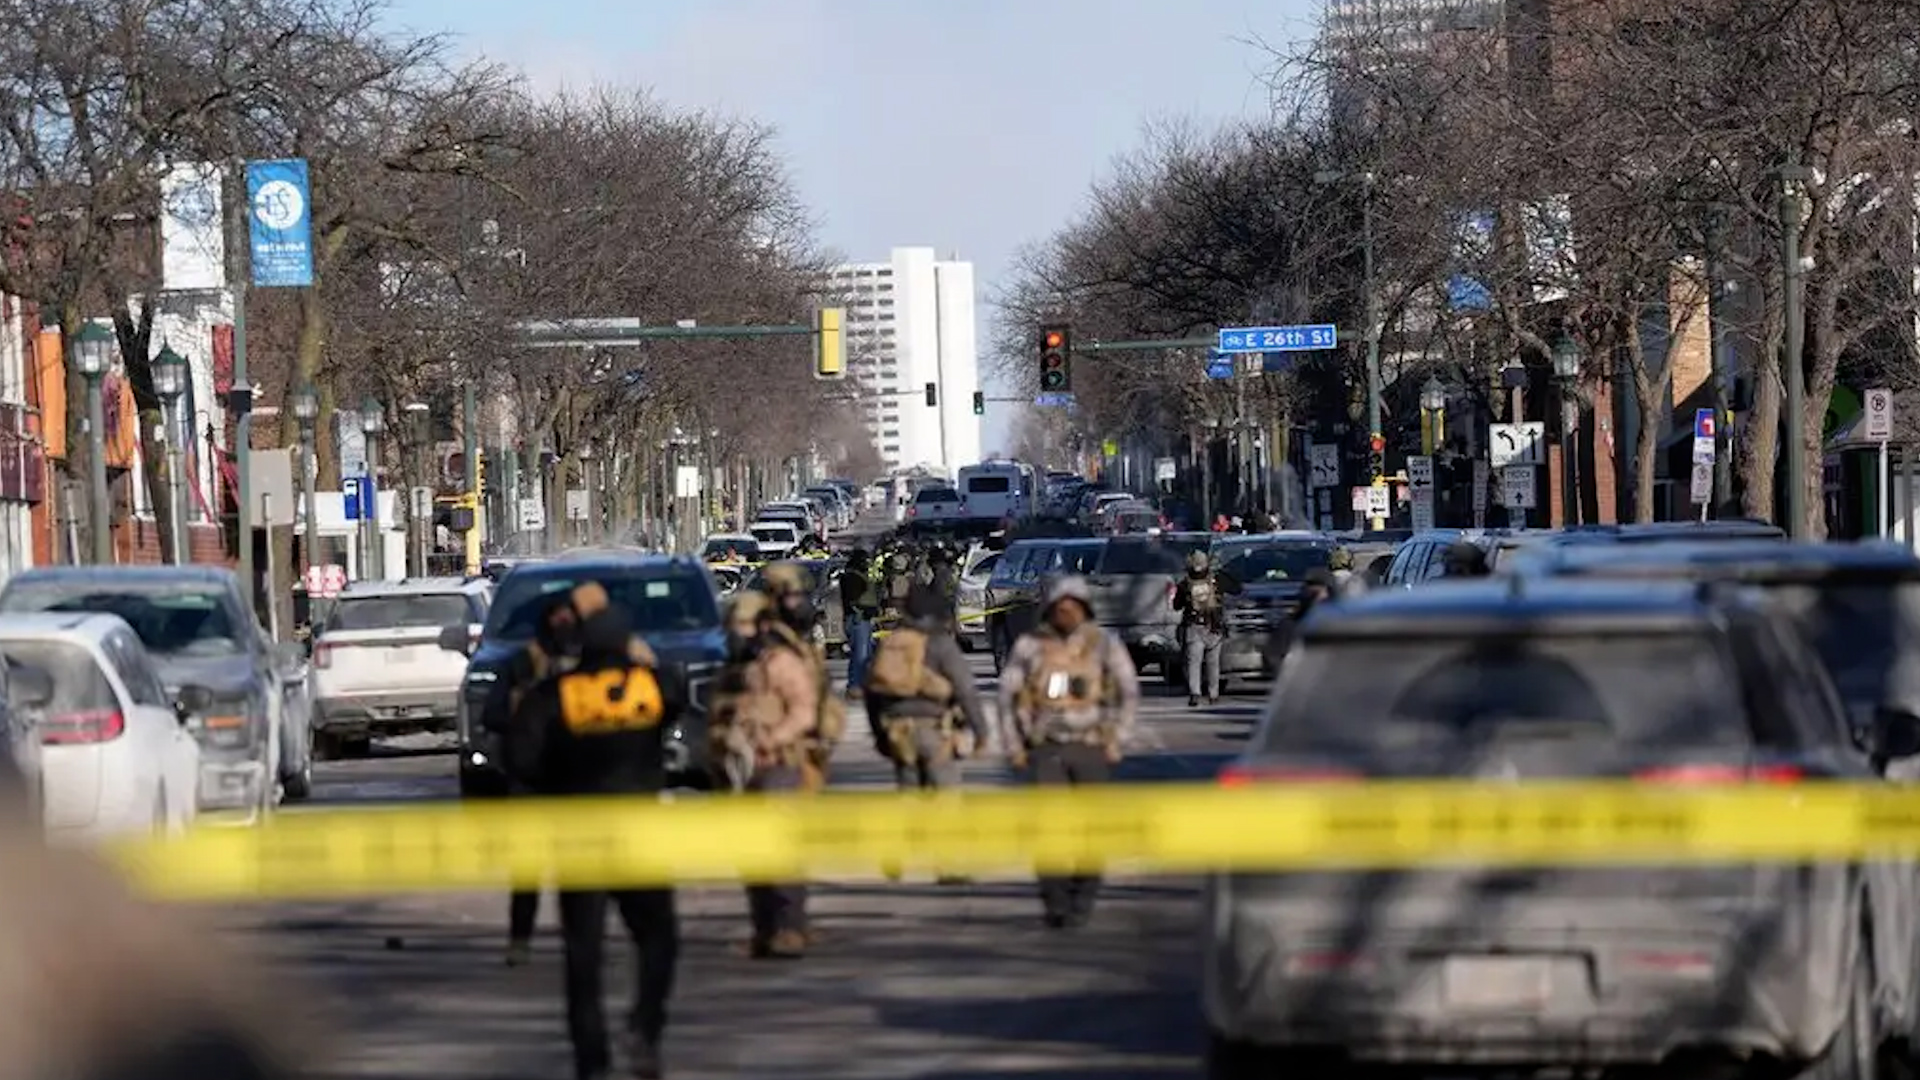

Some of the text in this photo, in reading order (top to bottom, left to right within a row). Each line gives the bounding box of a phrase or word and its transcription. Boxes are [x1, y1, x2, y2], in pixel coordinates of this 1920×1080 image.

[1245, 330, 1332, 347] E 26th St
